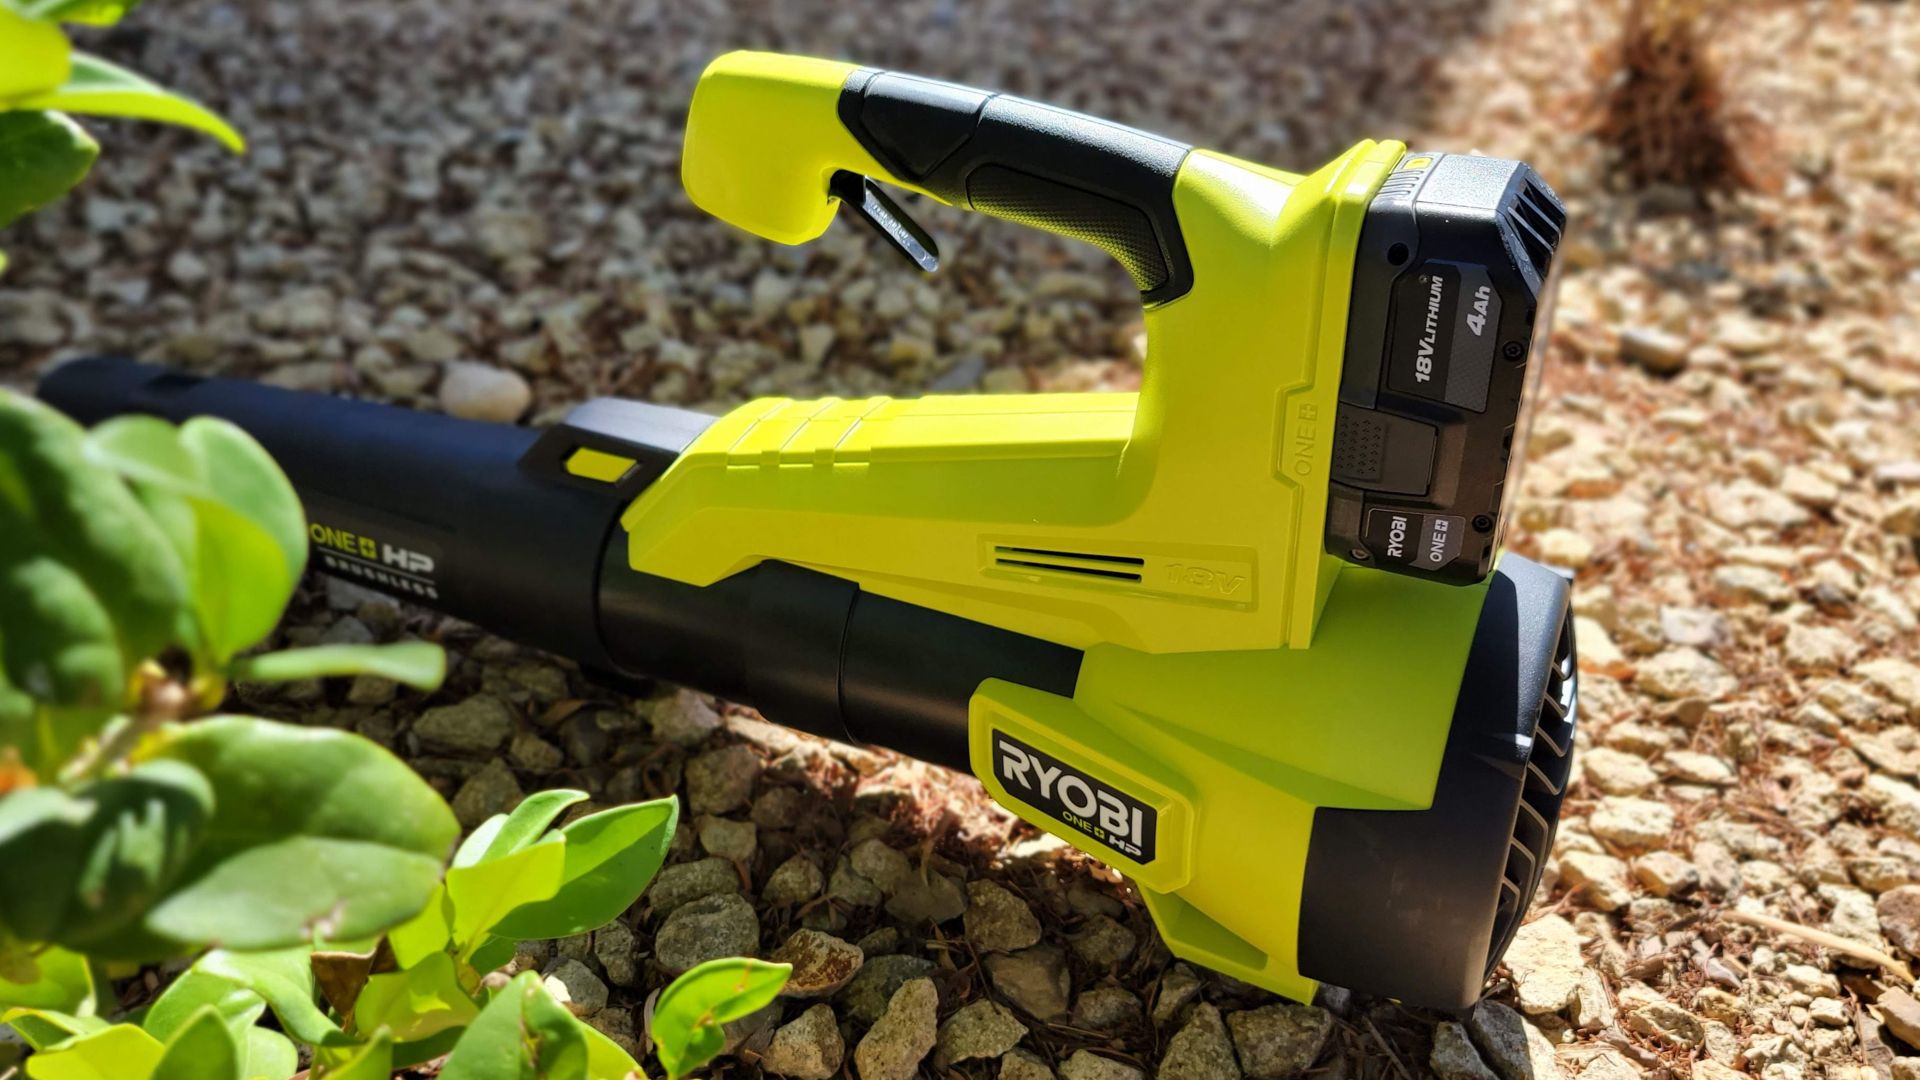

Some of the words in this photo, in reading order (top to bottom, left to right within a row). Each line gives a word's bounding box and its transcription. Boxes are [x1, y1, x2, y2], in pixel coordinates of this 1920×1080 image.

[1466, 285, 1491, 336] 4Ah
[1387, 516, 1408, 558] RYOBI
[382, 543, 435, 573] HP
[1165, 563, 1247, 595] 18V
[999, 740, 1143, 847] RYOBI
[1108, 834, 1142, 856] HP
